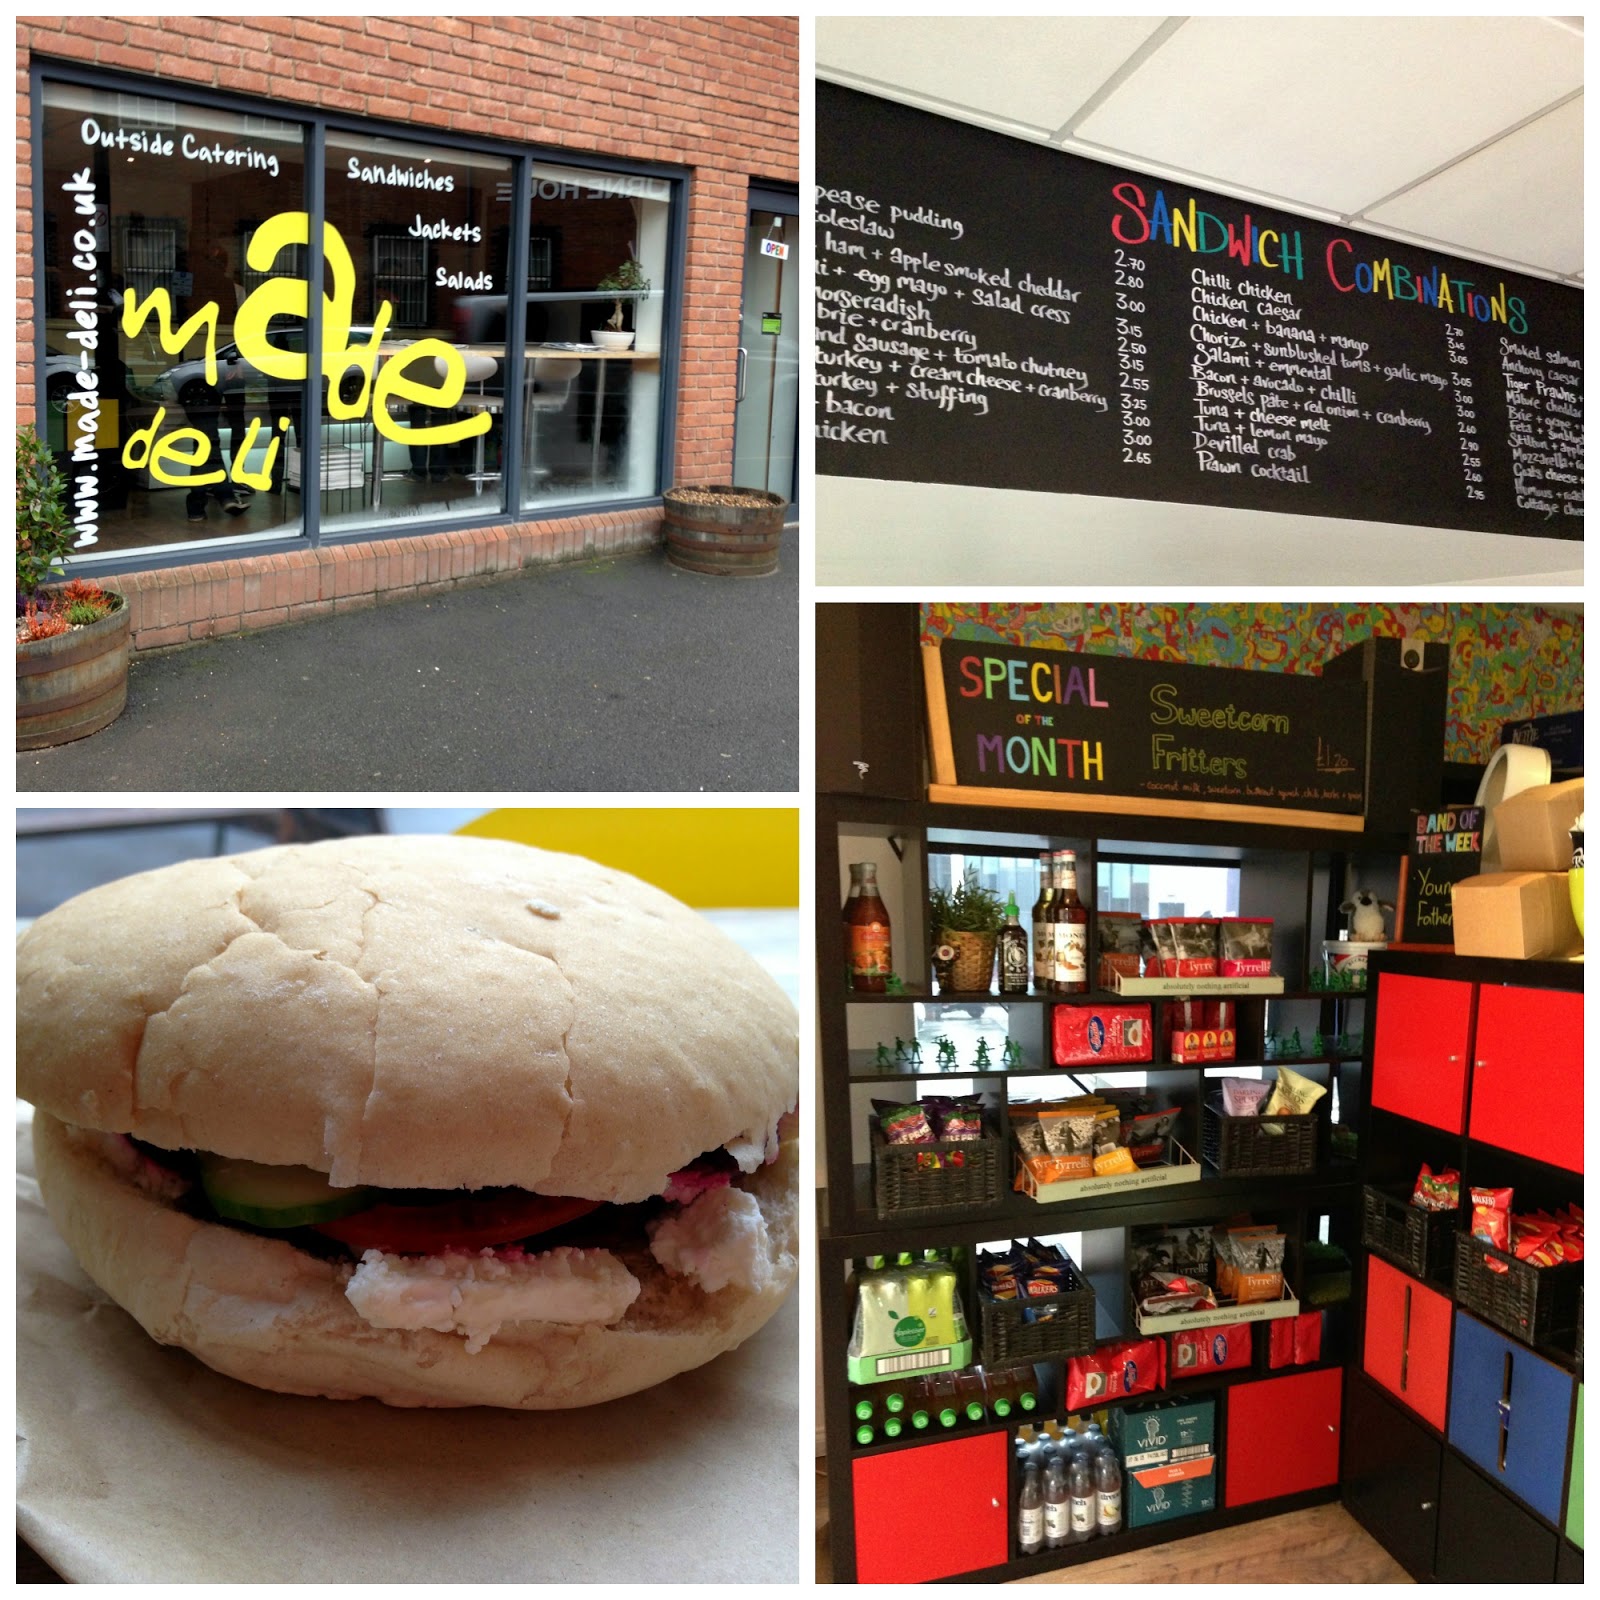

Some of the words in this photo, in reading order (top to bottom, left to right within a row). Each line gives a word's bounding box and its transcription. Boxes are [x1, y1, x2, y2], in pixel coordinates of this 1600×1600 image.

[80, 118, 174, 157] Outside
[182, 133, 280, 177] Catering
[346, 157, 455, 193] Sandwiches
[408, 213, 482, 244] Jackets
[815, 185, 881, 214] pease
[890, 205, 964, 241] pudding
[765, 242, 785, 257] OPEN
[825, 230, 868, 260] ham
[890, 247, 941, 273] apple
[943, 262, 1012, 289] smoked
[1017, 272, 1082, 303] cheddar
[1111, 182, 1304, 281] SANDWICH
[1326, 238, 1529, 335] COMBINATIONS
[1114, 248, 1146, 272] 2.70
[435, 267, 493, 291] Salads
[1114, 269, 1145, 290] 2.80
[1191, 267, 1232, 291] Chilli
[1237, 280, 1294, 306] chicken
[896, 276, 948, 301] mayo
[1029, 302, 1071, 325] cress
[1115, 292, 1146, 314] 3.00
[1191, 286, 1250, 313] Chicken
[121, 211, 492, 446] made
[816, 301, 865, 328] brie
[881, 317, 978, 352] cranberry
[1115, 317, 1143, 338] 3.15
[1192, 306, 1250, 330] Chicken
[1265, 320, 1316, 344] banana
[1330, 334, 1369, 359] mango
[61, 166, 101, 549] www.made-deli.co.uk
[1117, 336, 1147, 355] 2.50
[1119, 353, 1145, 372] 3.15
[1190, 323, 1247, 348] Chorizo
[1263, 342, 1338, 367] sunblushed
[1340, 353, 1372, 373] toms
[1383, 363, 1417, 382] garlic
[1420, 372, 1449, 391] mayo
[1193, 342, 1251, 368] Salami
[1268, 361, 1332, 381] emmental
[815, 345, 883, 374] turkey
[910, 362, 963, 384] cream
[965, 366, 1022, 392] cheese
[1037, 383, 1109, 413] cranberry
[954, 348, 1018, 371] tomato
[1021, 356, 1089, 391] chutney
[1119, 372, 1150, 391] 2.55
[1189, 363, 1237, 384] Bacon
[1252, 375, 1304, 394] avocado
[1320, 386, 1358, 405] chilli
[1502, 372, 1531, 394] Tiger
[826, 390, 896, 421] bacon
[1120, 393, 1148, 411] 3.25
[1122, 410, 1151, 428] 3.00
[1193, 398, 1229, 419] Tuna
[1250, 406, 1297, 427] cheese
[1300, 415, 1332, 432] melt
[1196, 381, 1255, 405] Brussels
[1304, 400, 1324, 415] red
[1326, 404, 1360, 419] onion
[1376, 409, 1433, 436] cranberry
[121, 406, 291, 491] deli
[1122, 429, 1153, 447] 3.00
[1192, 431, 1260, 456] Devilled
[1268, 443, 1297, 461] crab
[1194, 415, 1231, 434] Tuna
[1250, 422, 1291, 442] lemon
[1295, 432, 1328, 451] mayo
[1122, 447, 1152, 465] 2.65
[959, 655, 1109, 708] SPECIAL
[1015, 713, 1032, 725] OF
[1034, 715, 1054, 727] THE
[1149, 683, 1290, 734] Sweetcorn
[976, 733, 1104, 781] MONTH
[1151, 733, 1248, 779] Fritters
[1416, 811, 1456, 834] BAND
[1459, 808, 1479, 829] OF
[1416, 834, 1442, 854] THE
[1445, 832, 1480, 853] WEEK
[1136, 1434, 1168, 1448] VIVID
